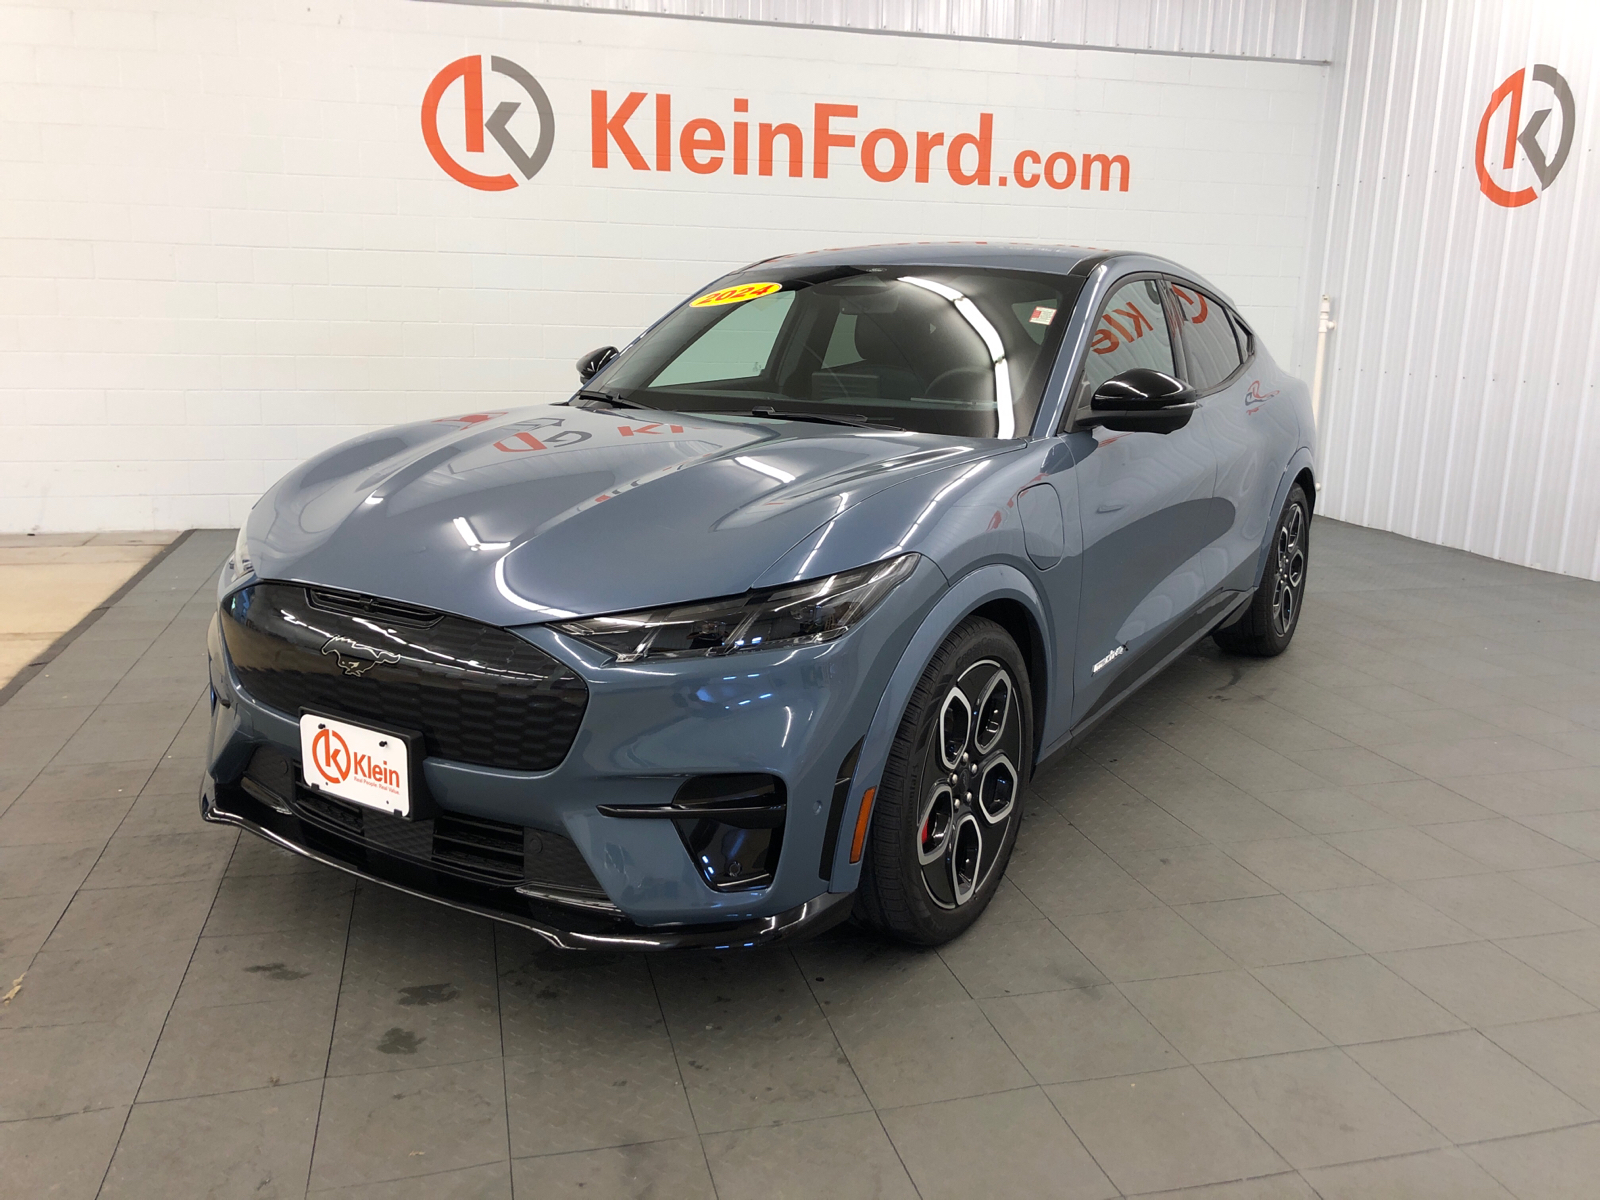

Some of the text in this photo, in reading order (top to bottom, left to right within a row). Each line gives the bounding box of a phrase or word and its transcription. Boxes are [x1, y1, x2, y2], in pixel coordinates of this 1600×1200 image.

[591, 88, 1131, 193] KleinFord.com
[696, 284, 775, 305] 2024
[353, 751, 400, 789] Klein
